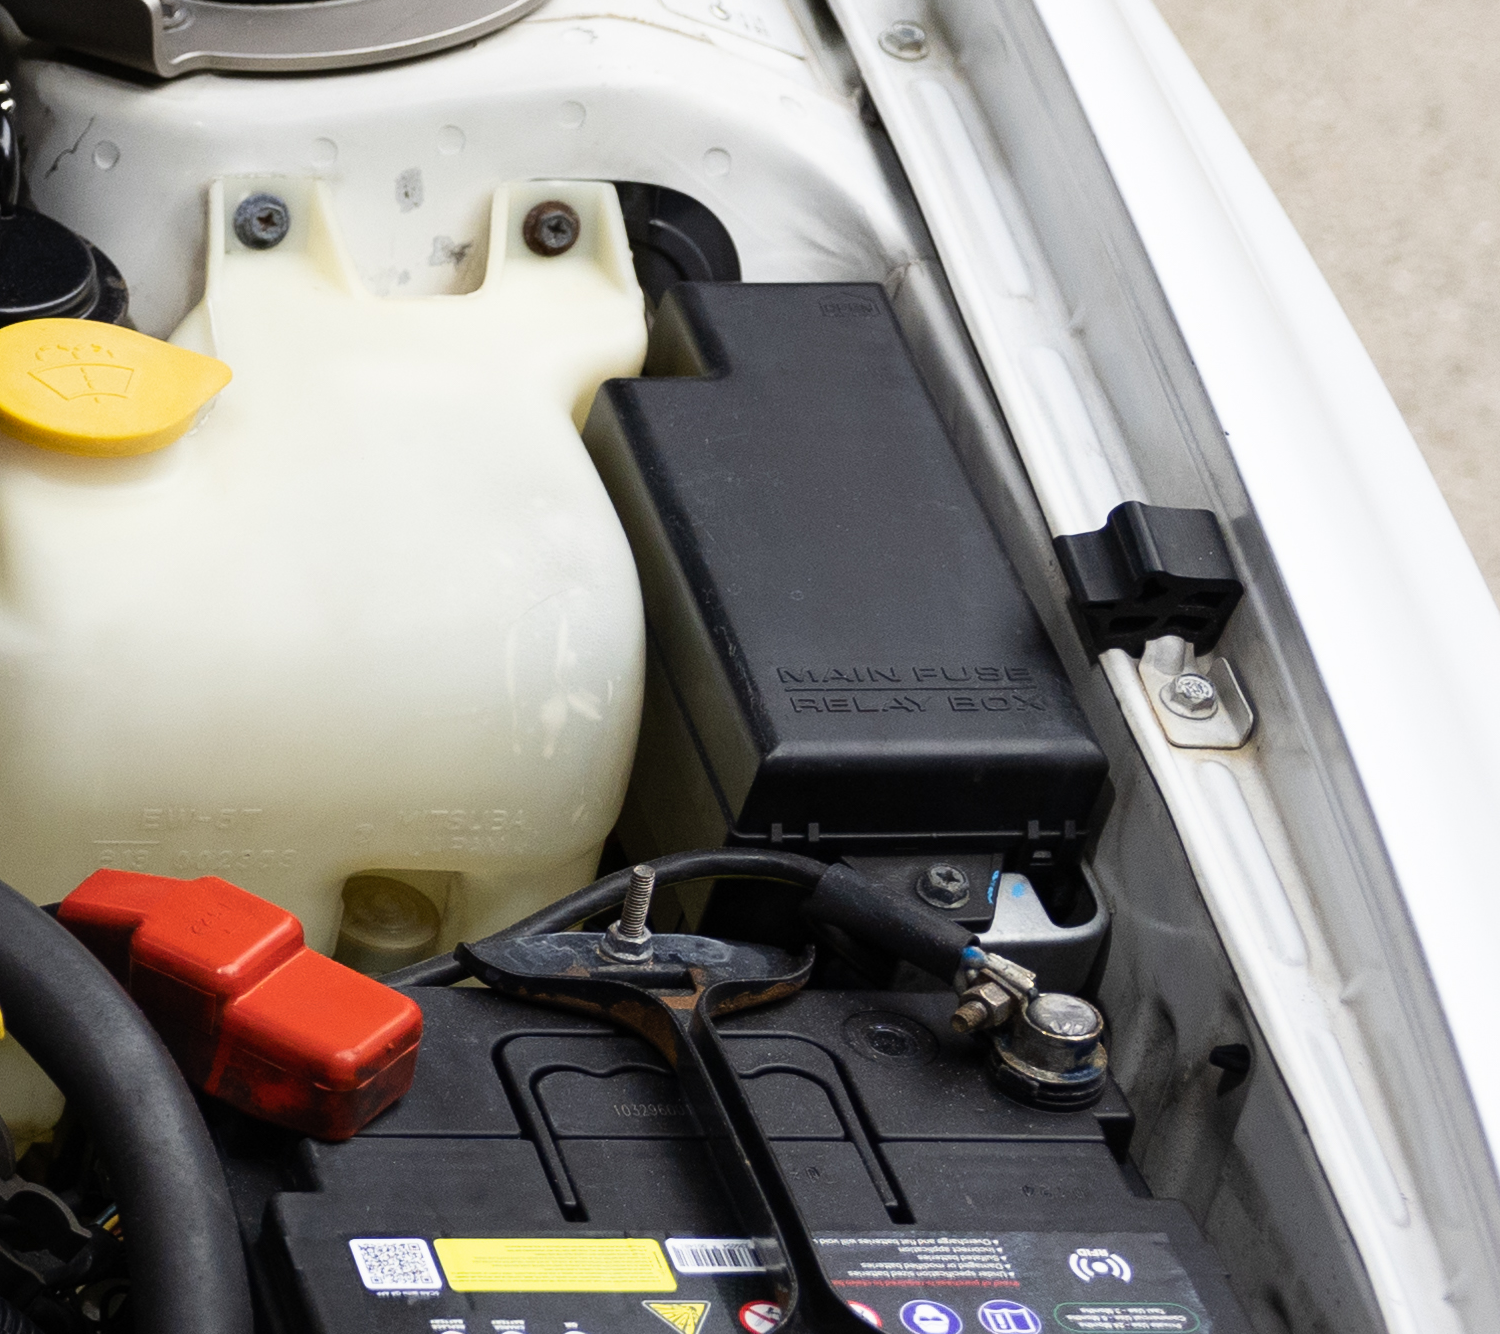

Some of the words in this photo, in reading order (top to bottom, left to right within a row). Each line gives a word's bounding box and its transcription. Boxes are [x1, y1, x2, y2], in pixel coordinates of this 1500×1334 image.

[776, 665, 902, 684] MAIN
[913, 665, 1034, 683] FUSE
[790, 694, 933, 713] RELAY
[947, 694, 1048, 713] BOX
[937, 1237, 992, 1245] Overcharge
[1076, 1248, 1108, 1257] RFID
